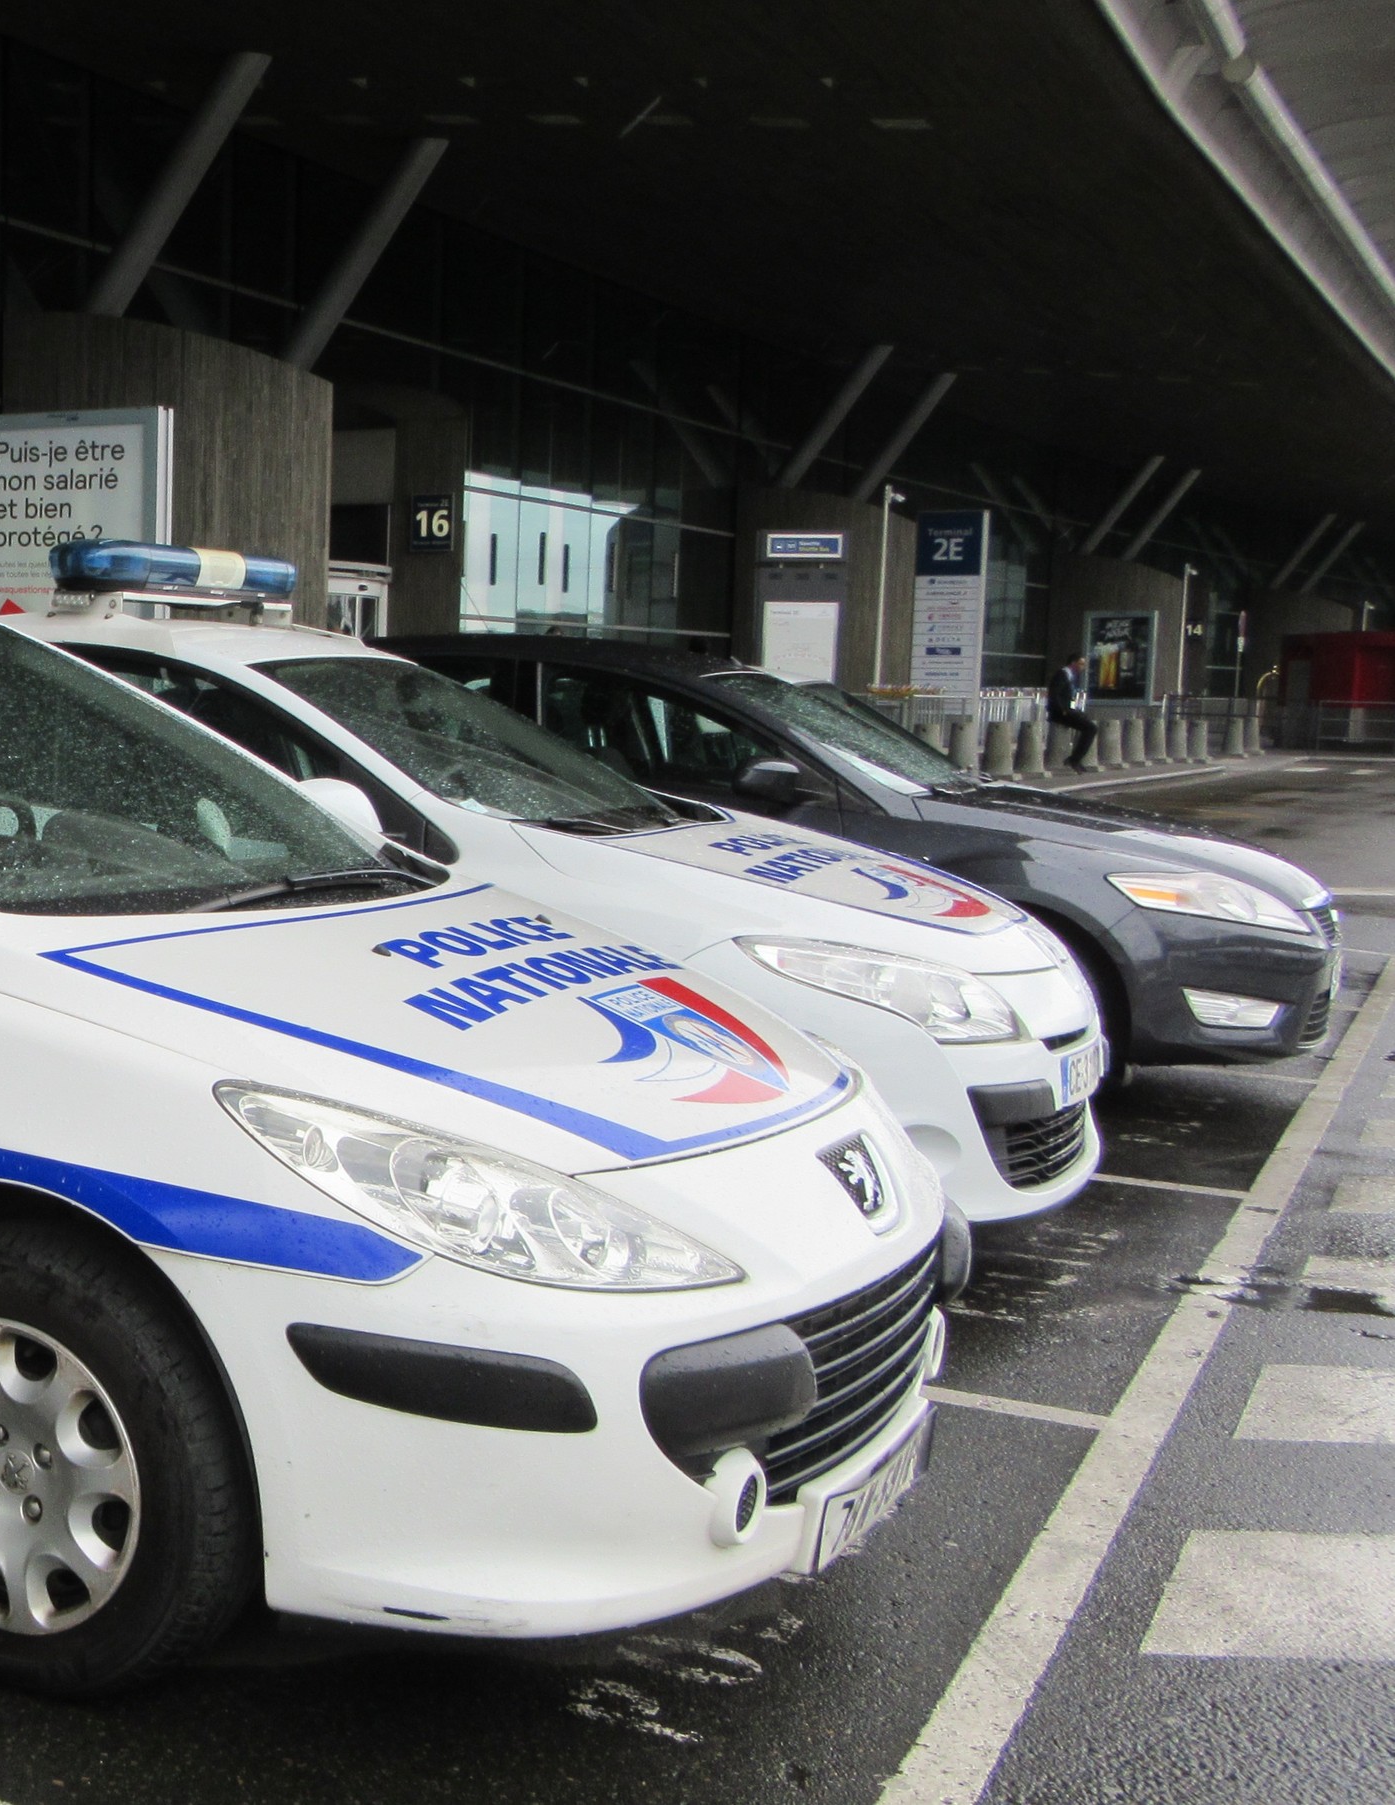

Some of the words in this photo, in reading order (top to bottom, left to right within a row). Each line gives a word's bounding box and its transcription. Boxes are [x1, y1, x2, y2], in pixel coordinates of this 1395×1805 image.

[75, 439, 125, 461] être
[43, 467, 119, 491] salarié
[25, 497, 72, 519] bien
[416, 509, 450, 537] 16
[927, 527, 973, 537] Terminal
[932, 537, 964, 561] 2E
[1186, 624, 1203, 636] 14
[384, 916, 576, 969] POLICE
[403, 944, 685, 1031] NATIONALE
[608, 990, 655, 1008] POLICE
